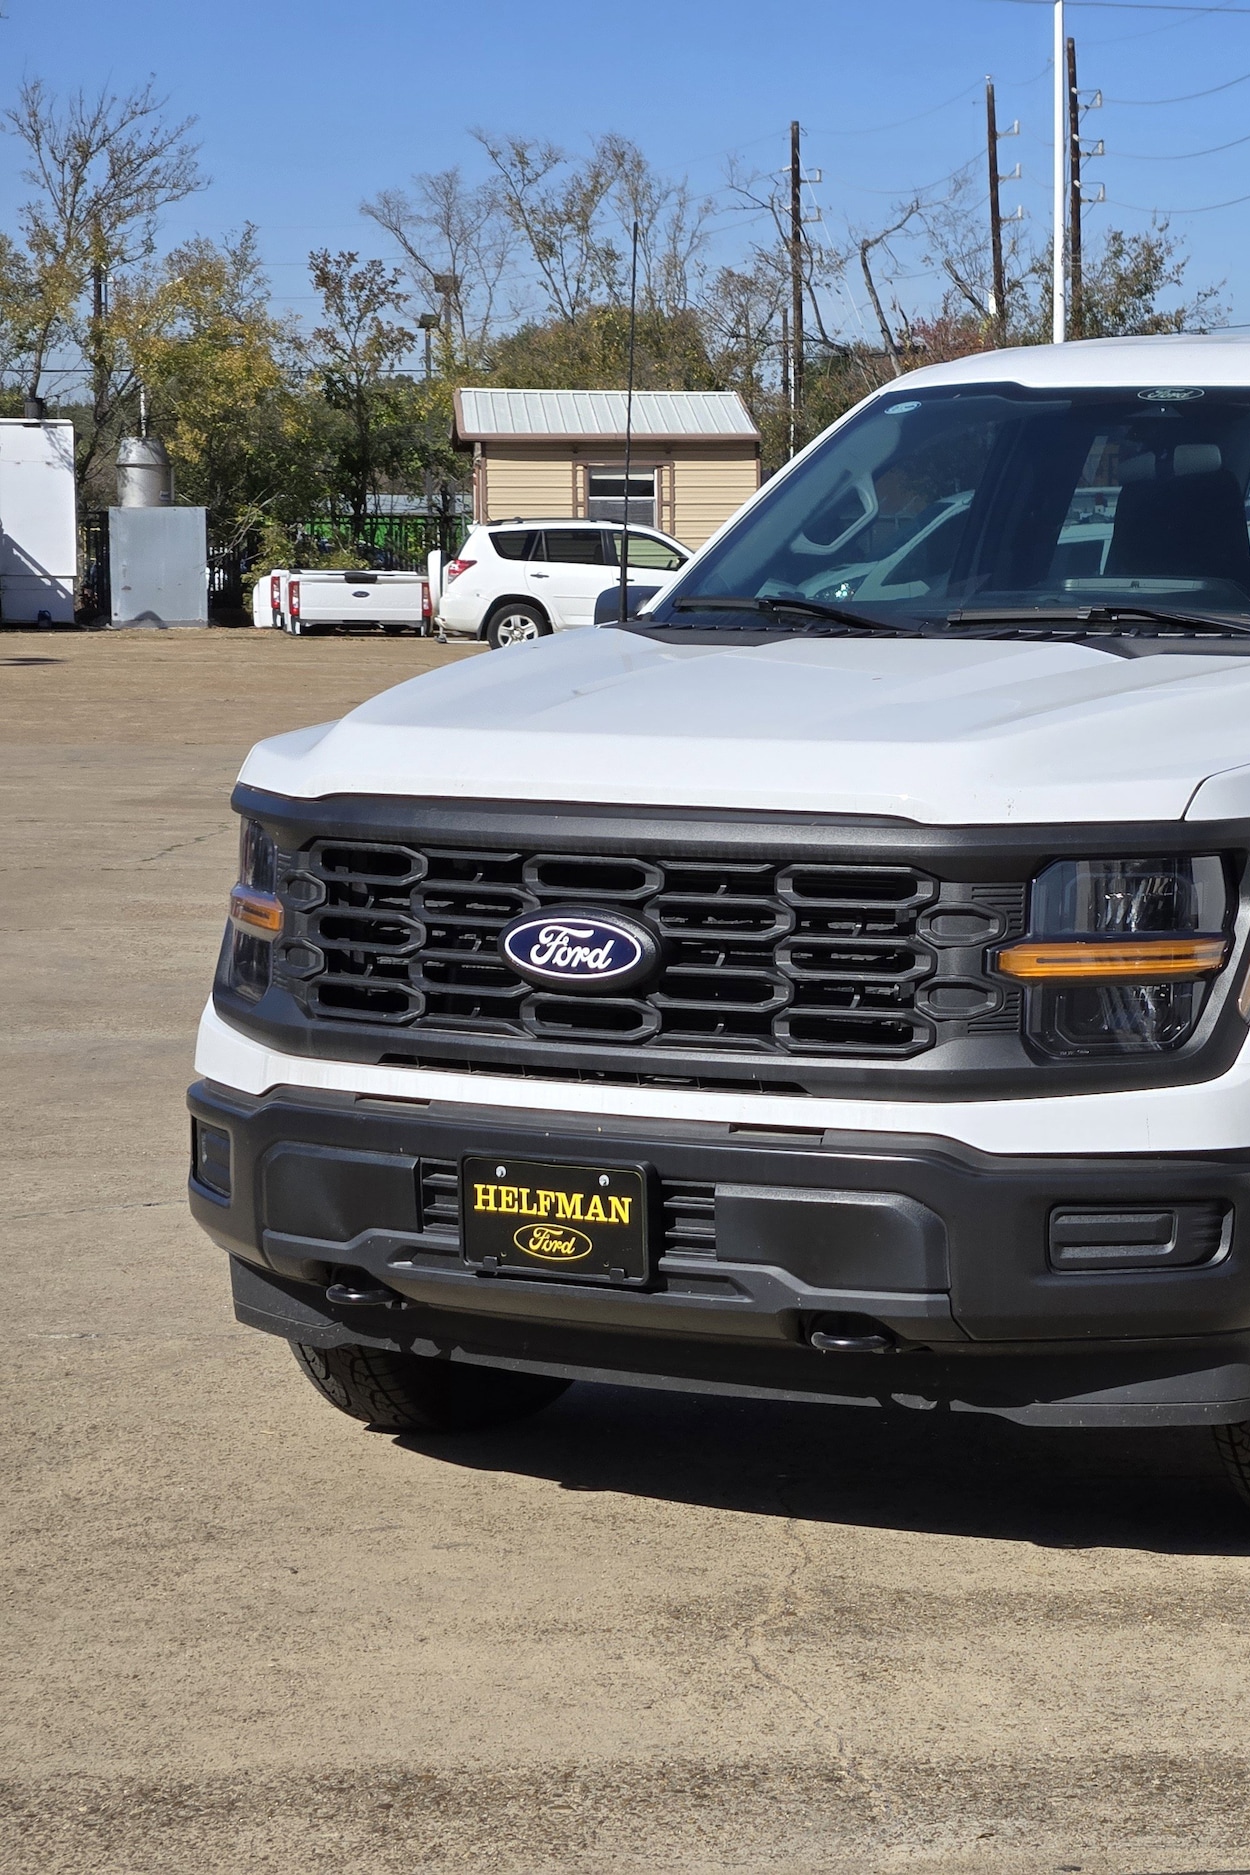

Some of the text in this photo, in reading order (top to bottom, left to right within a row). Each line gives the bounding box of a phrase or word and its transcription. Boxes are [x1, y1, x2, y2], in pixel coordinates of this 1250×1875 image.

[1147, 387, 1194, 399] Ford
[529, 924, 615, 970] Ford
[472, 1182, 633, 1224] HELFMAN
[528, 1226, 577, 1256] Ford
